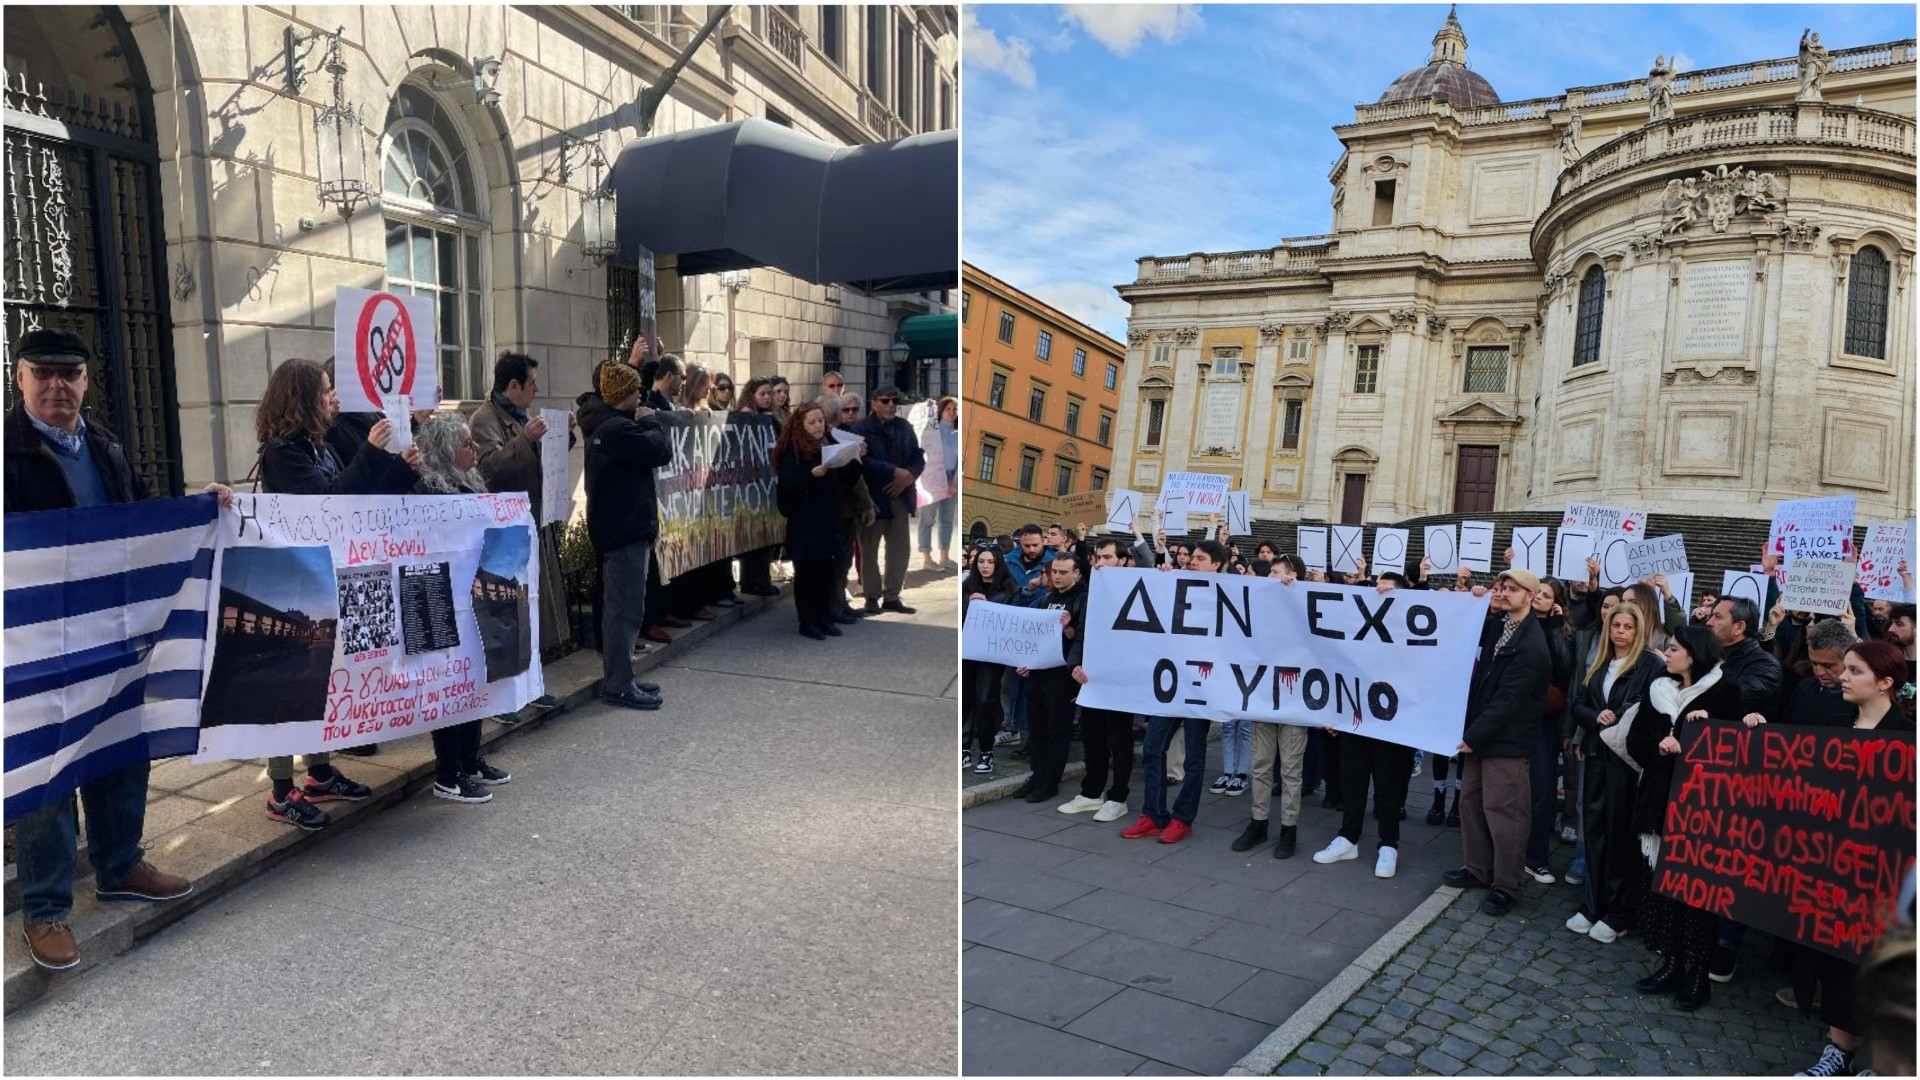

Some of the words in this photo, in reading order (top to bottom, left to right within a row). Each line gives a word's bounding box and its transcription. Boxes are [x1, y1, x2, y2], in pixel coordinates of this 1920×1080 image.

[710, 475, 779, 521] ΤΕΛΟΥ
[1570, 505, 1584, 516] WE
[1586, 506, 1620, 519] DEMAND
[238, 495, 264, 541] Η
[1581, 516, 1620, 530] JUSTICE
[1628, 543, 1656, 560] ΔΕΝ
[1630, 555, 1690, 578] ΟΞΥΓΟΝΟ
[1792, 560, 1808, 568] ΔΕΝ
[1793, 549, 1842, 560] ΒΛΑΧΟΣ
[1111, 576, 1253, 638] ΔΕΝ
[327, 667, 354, 695] Ω
[1152, 657, 1400, 726] ΟΞΥΓΟΝΟ
[1684, 725, 1752, 767] ΔΕΝ
[1667, 801, 1724, 839] NON
[1727, 813, 1766, 850] HO
[1774, 825, 1917, 895] OSSIGEN
[1658, 869, 1736, 920] NADIR
